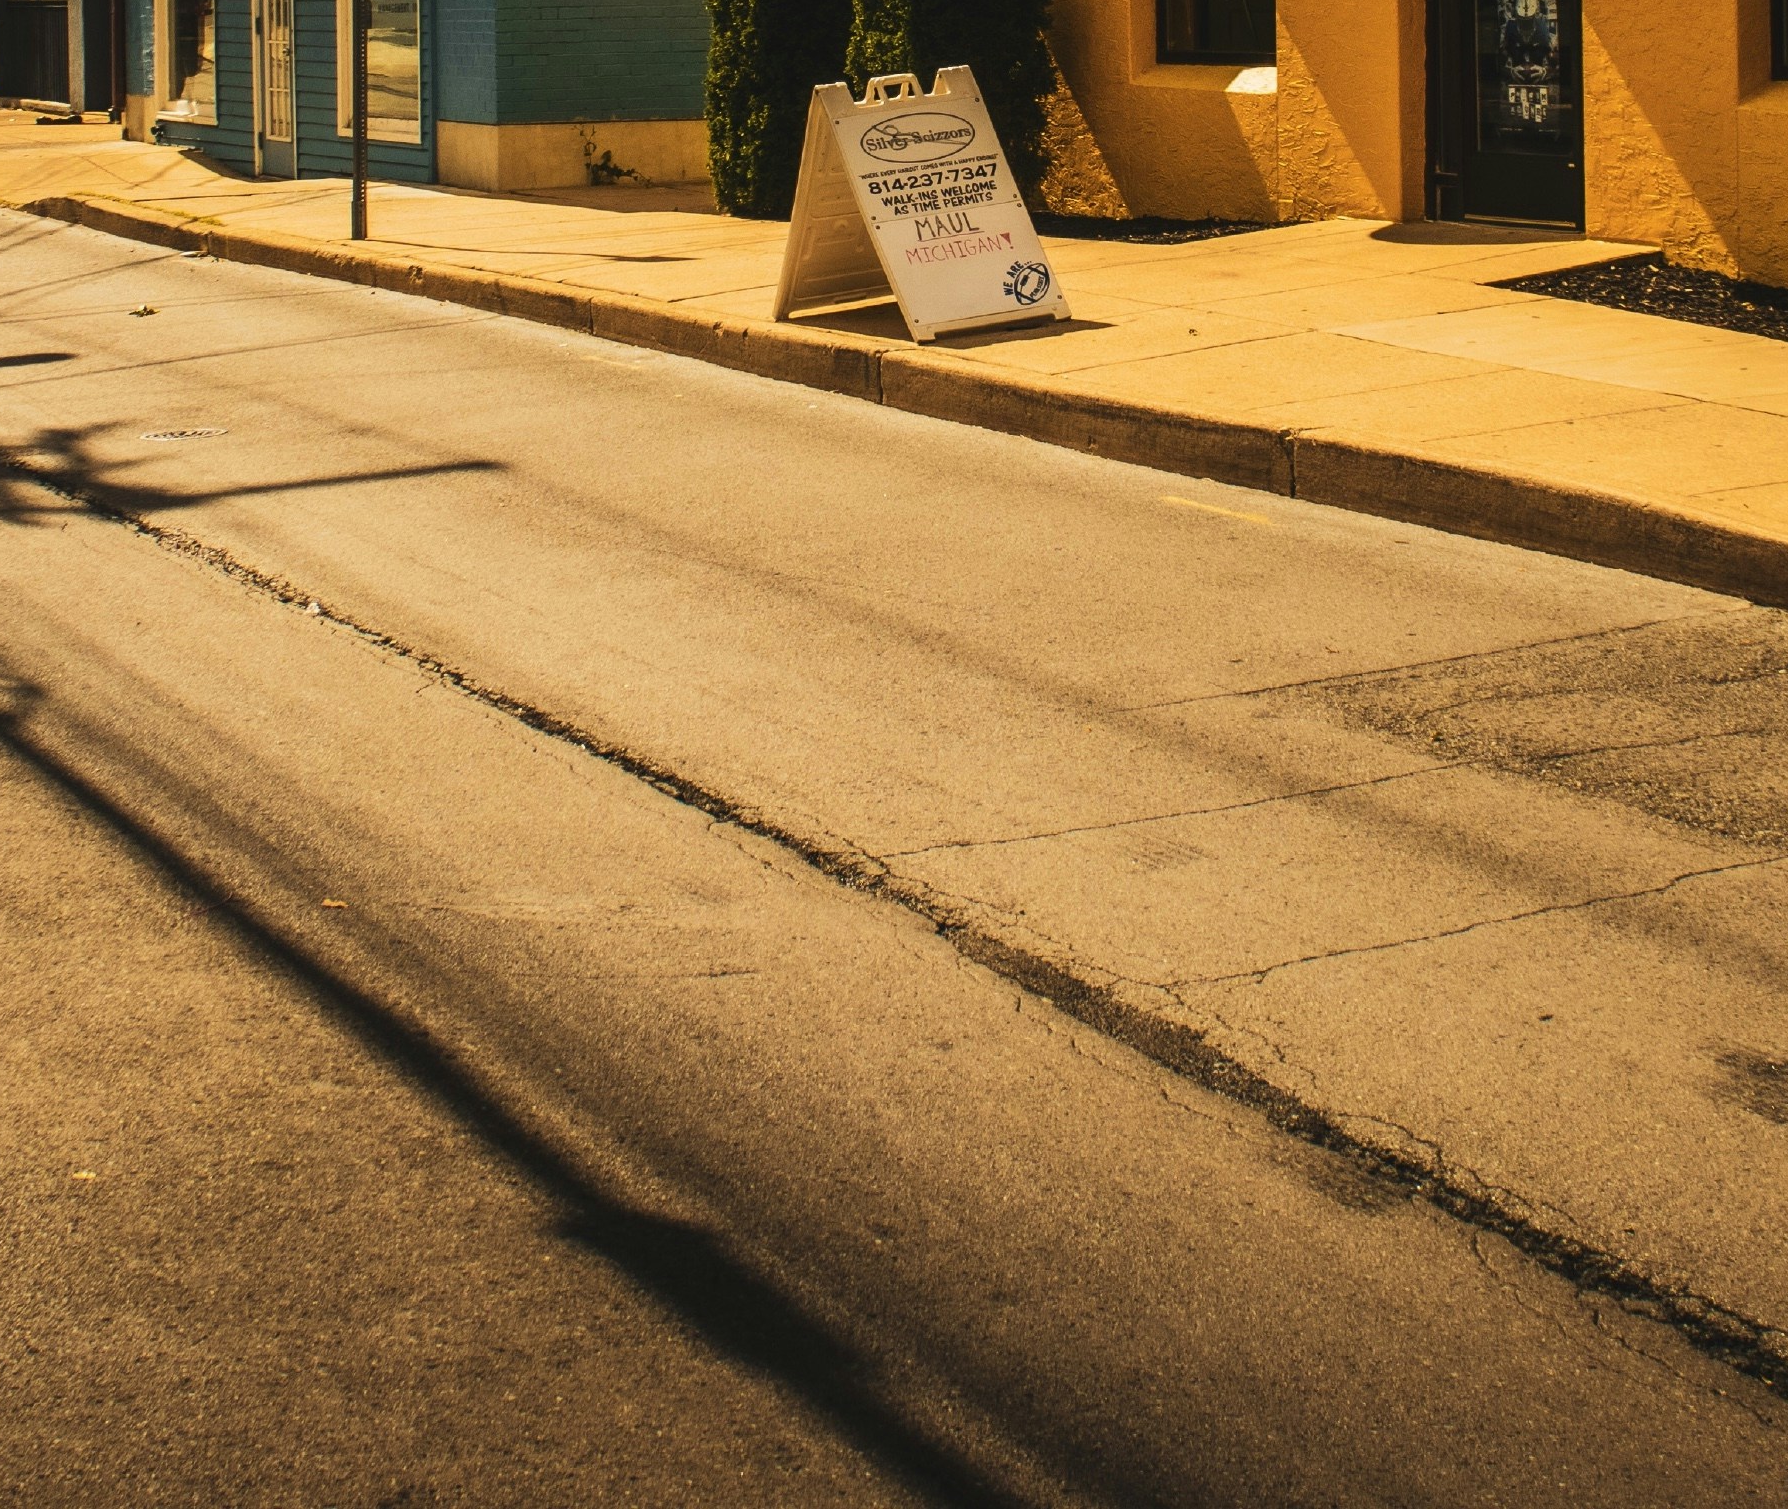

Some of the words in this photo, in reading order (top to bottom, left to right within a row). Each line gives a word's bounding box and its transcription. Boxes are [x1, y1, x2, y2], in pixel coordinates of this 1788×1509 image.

[865, 136, 910, 152] Silver
[911, 127, 972, 145] Scizzors
[868, 163, 997, 194] 814-237-7347
[881, 189, 939, 207] WALK-INS
[940, 180, 998, 197] WELCOME
[894, 205, 910, 216] AS
[911, 200, 942, 212] TIME
[943, 192, 994, 208] PERMITS
[914, 212, 980, 241] MAUL
[1003, 281, 1014, 296] WE
